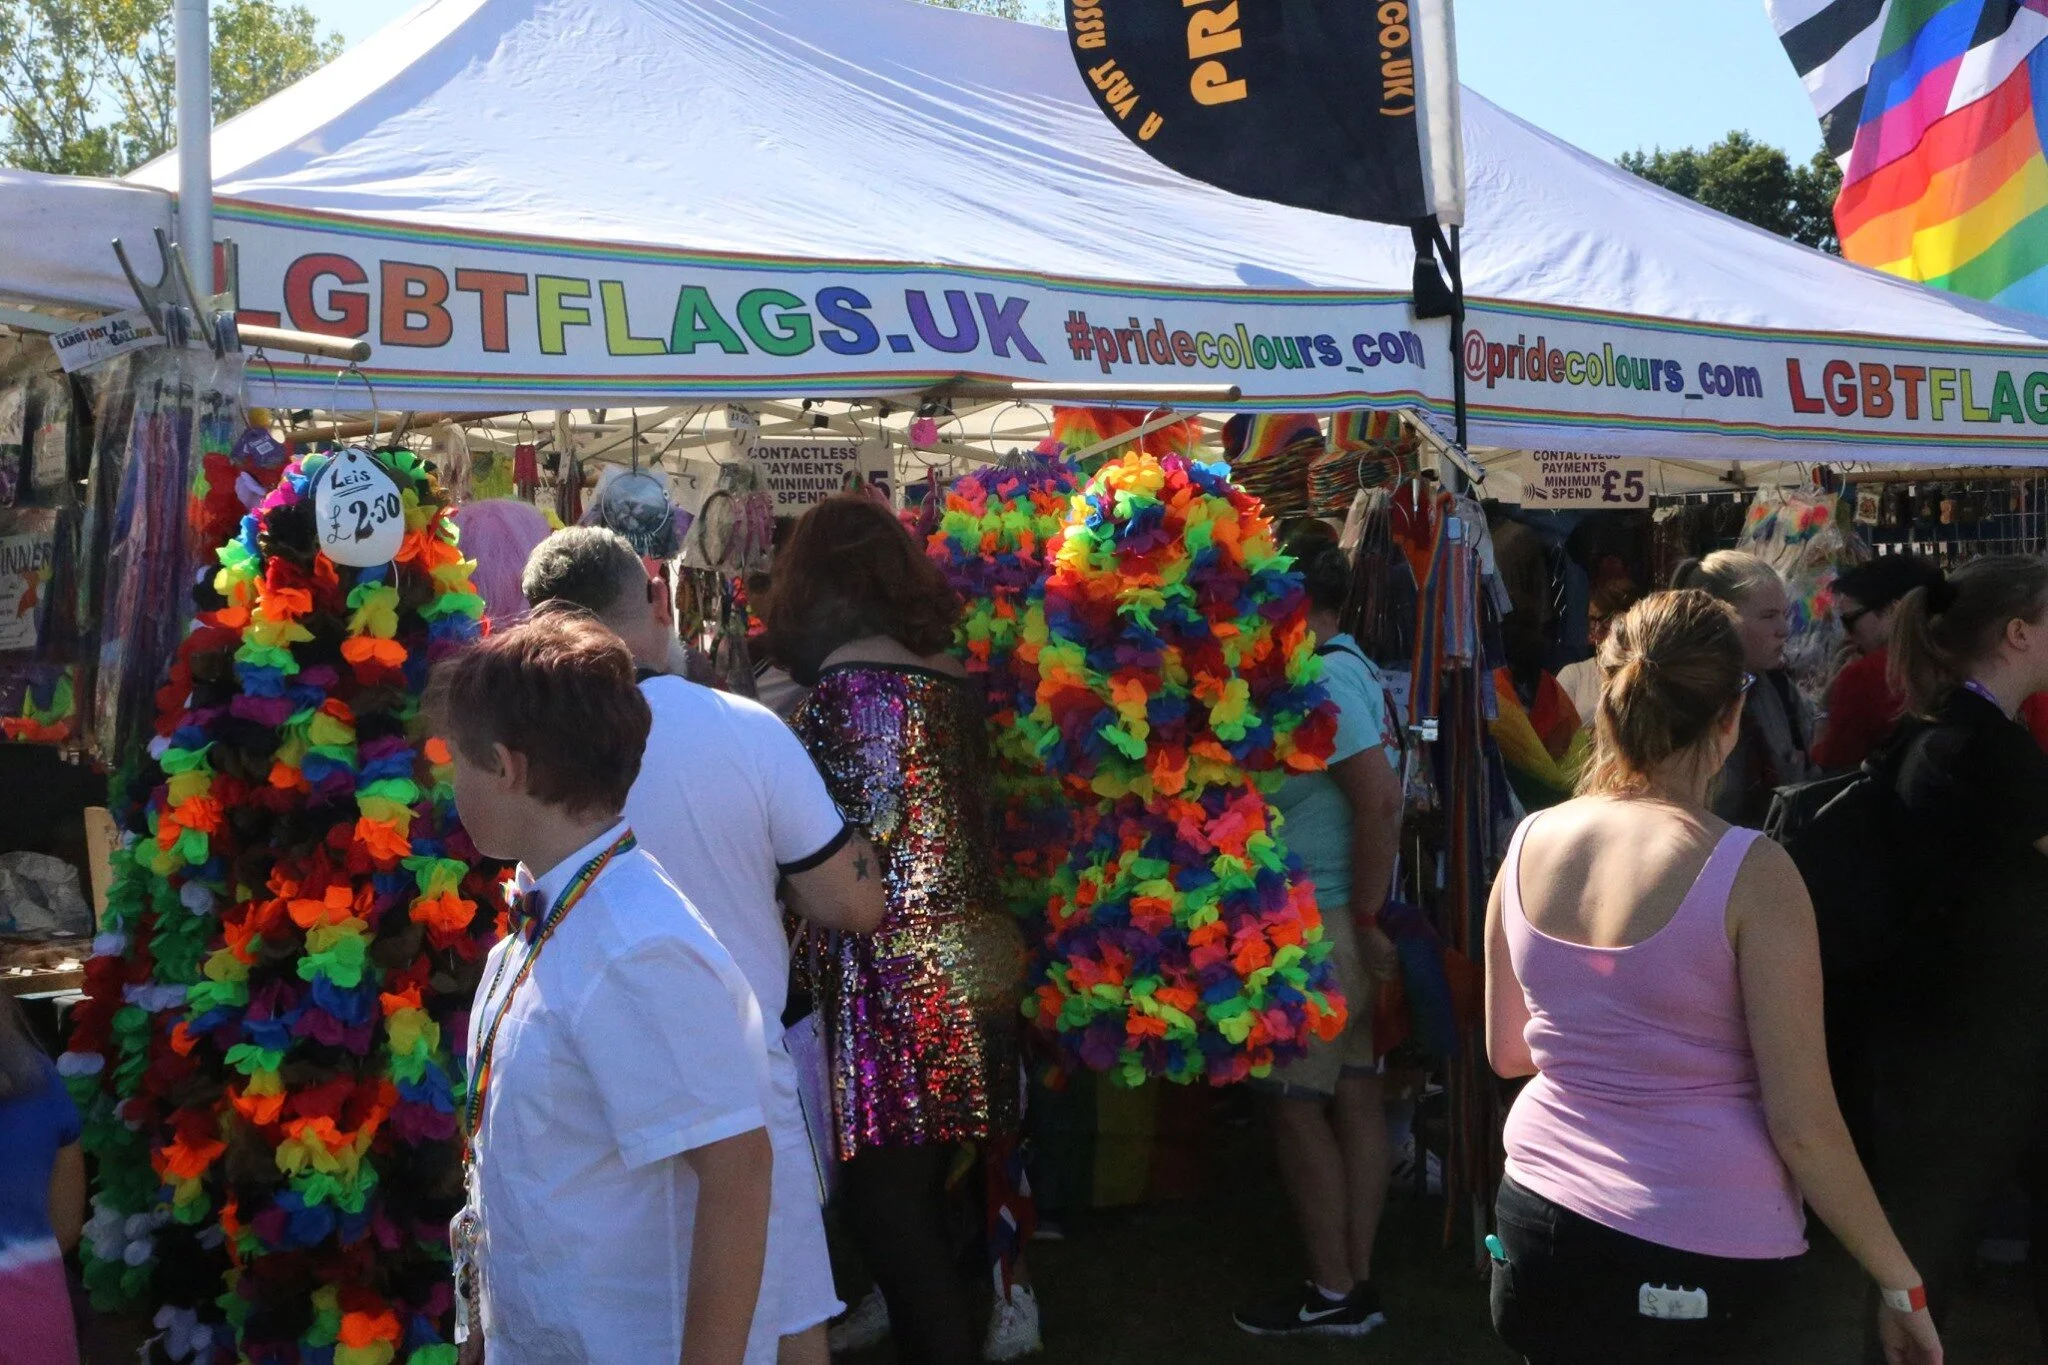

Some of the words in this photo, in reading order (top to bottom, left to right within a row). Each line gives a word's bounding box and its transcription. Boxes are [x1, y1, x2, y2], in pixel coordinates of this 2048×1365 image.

[1182, 0, 1248, 106] PR
[1088, 58, 1141, 121] VAST
[1064, 309, 1426, 375] #pridecolours_com
[1463, 328, 1764, 400] @pridecolours_com
[747, 447, 858, 460] CONTACTLESS
[1542, 461, 1607, 473] PAYMENTS
[766, 477, 838, 490] MINIMUM
[1544, 475, 1601, 487] MINIMUM
[1601, 470, 1645, 503] £5
[1552, 487, 1592, 499] SPEND
